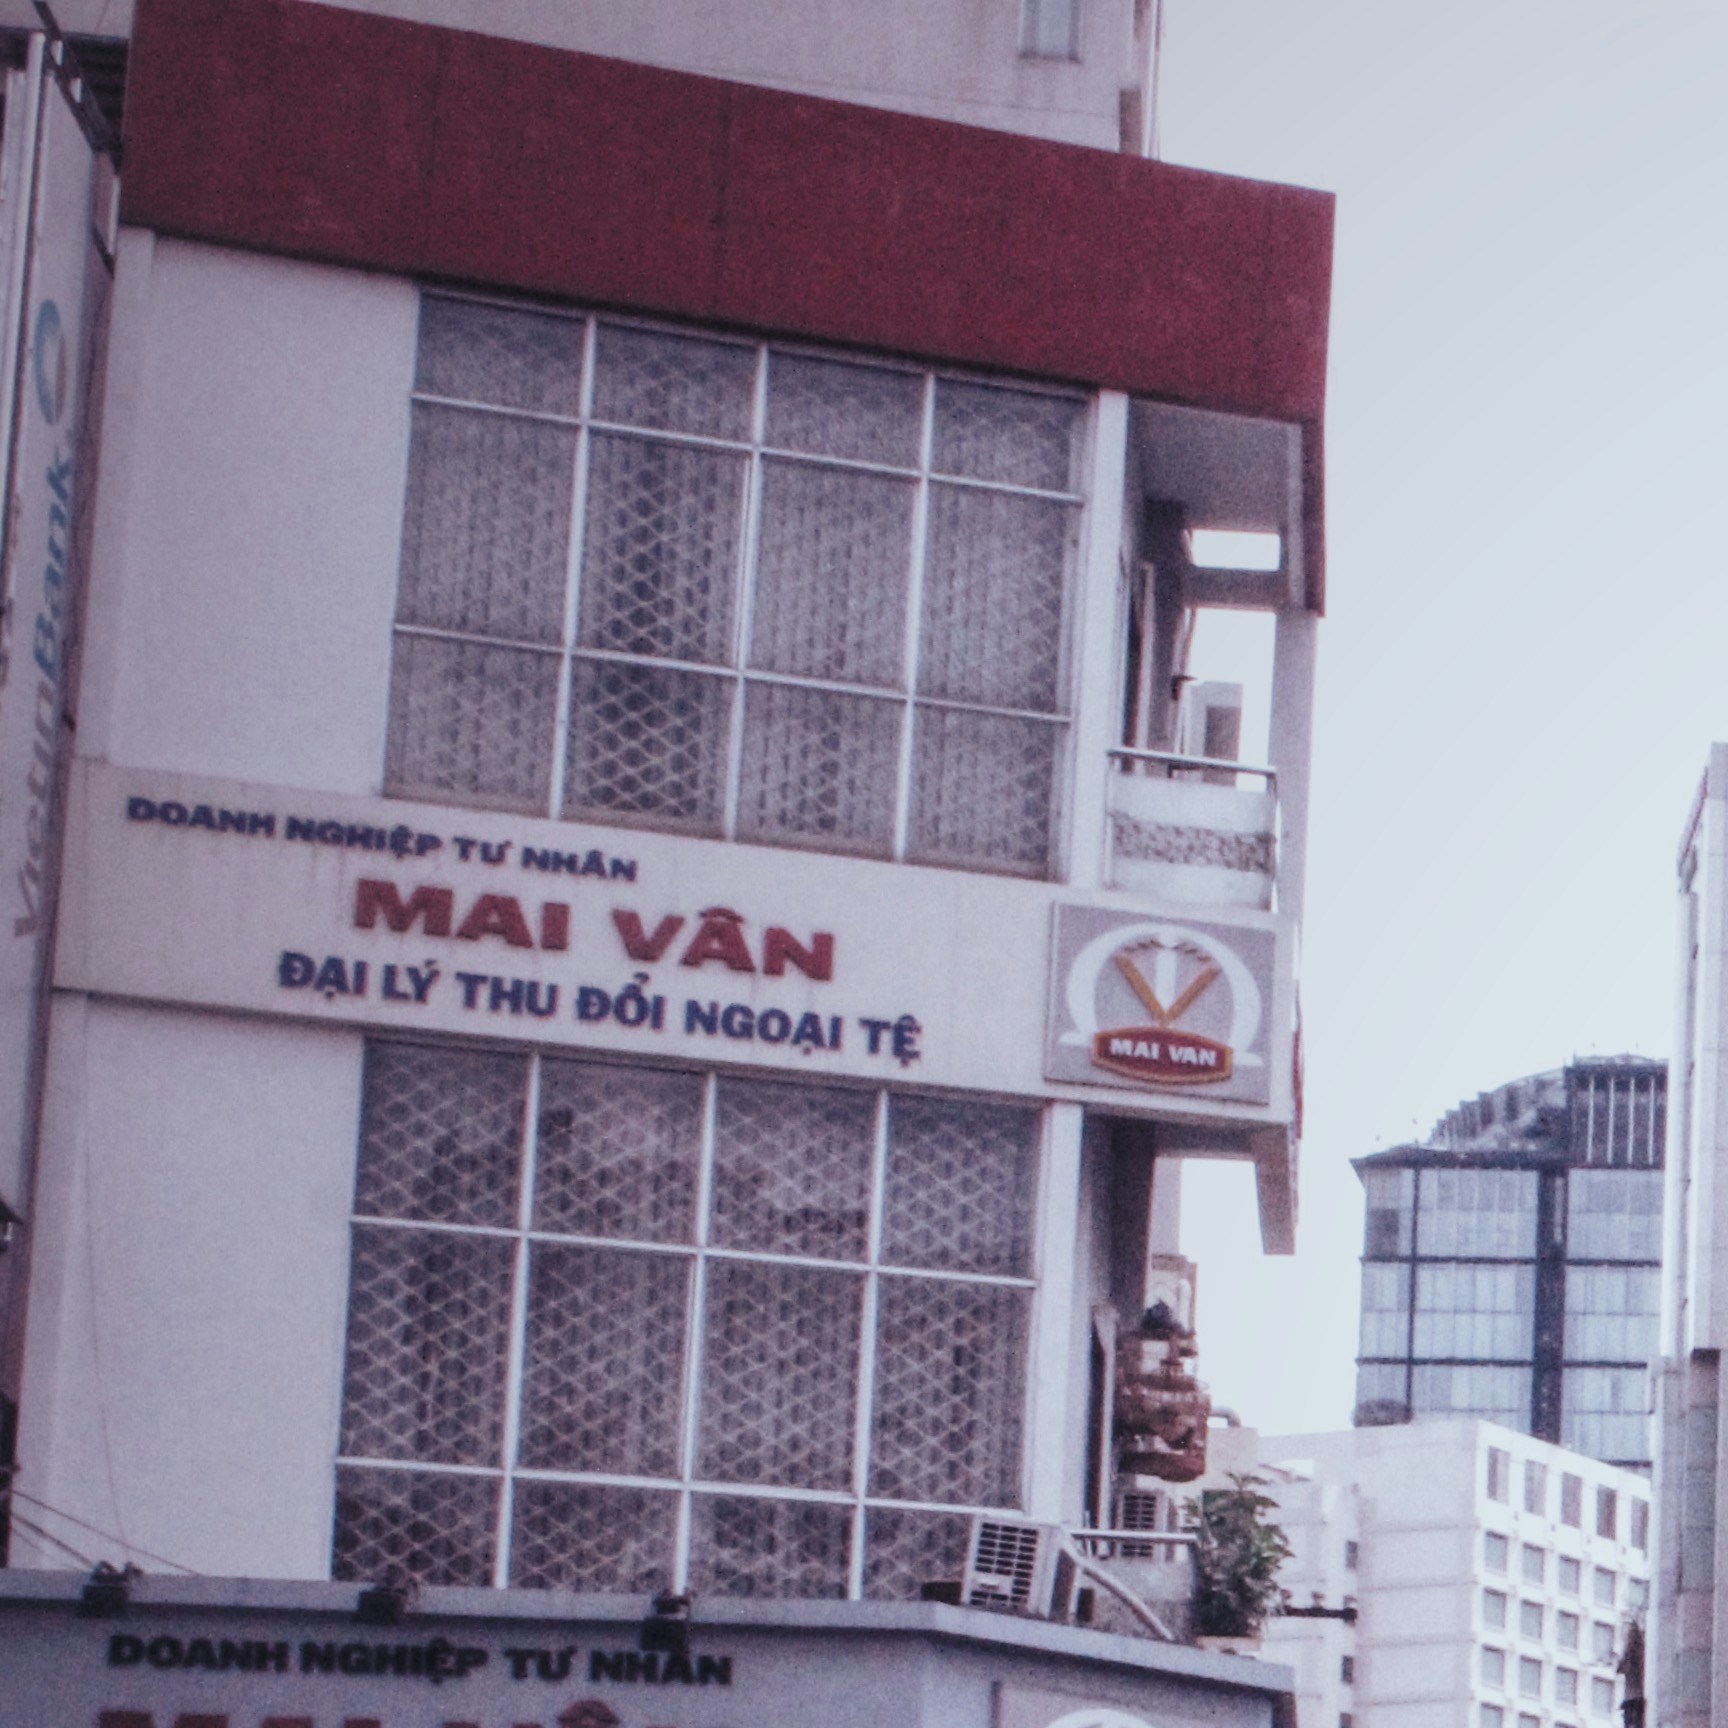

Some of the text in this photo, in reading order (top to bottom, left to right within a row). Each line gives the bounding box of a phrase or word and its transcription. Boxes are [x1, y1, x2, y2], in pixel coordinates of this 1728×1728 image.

[127, 797, 637, 882] DOANH NGHIỆP TƯ NHÂN
[354, 879, 834, 981] MAI VÂN
[278, 952, 921, 1067] ĐẠI LÝ THU ĐỔI NGOẠI TỆ
[1110, 1038, 1160, 1059] MAI
[108, 1634, 288, 1672] DOANH
[302, 1638, 489, 1683] NGHIỆP
[506, 1646, 577, 1682] TƯ
